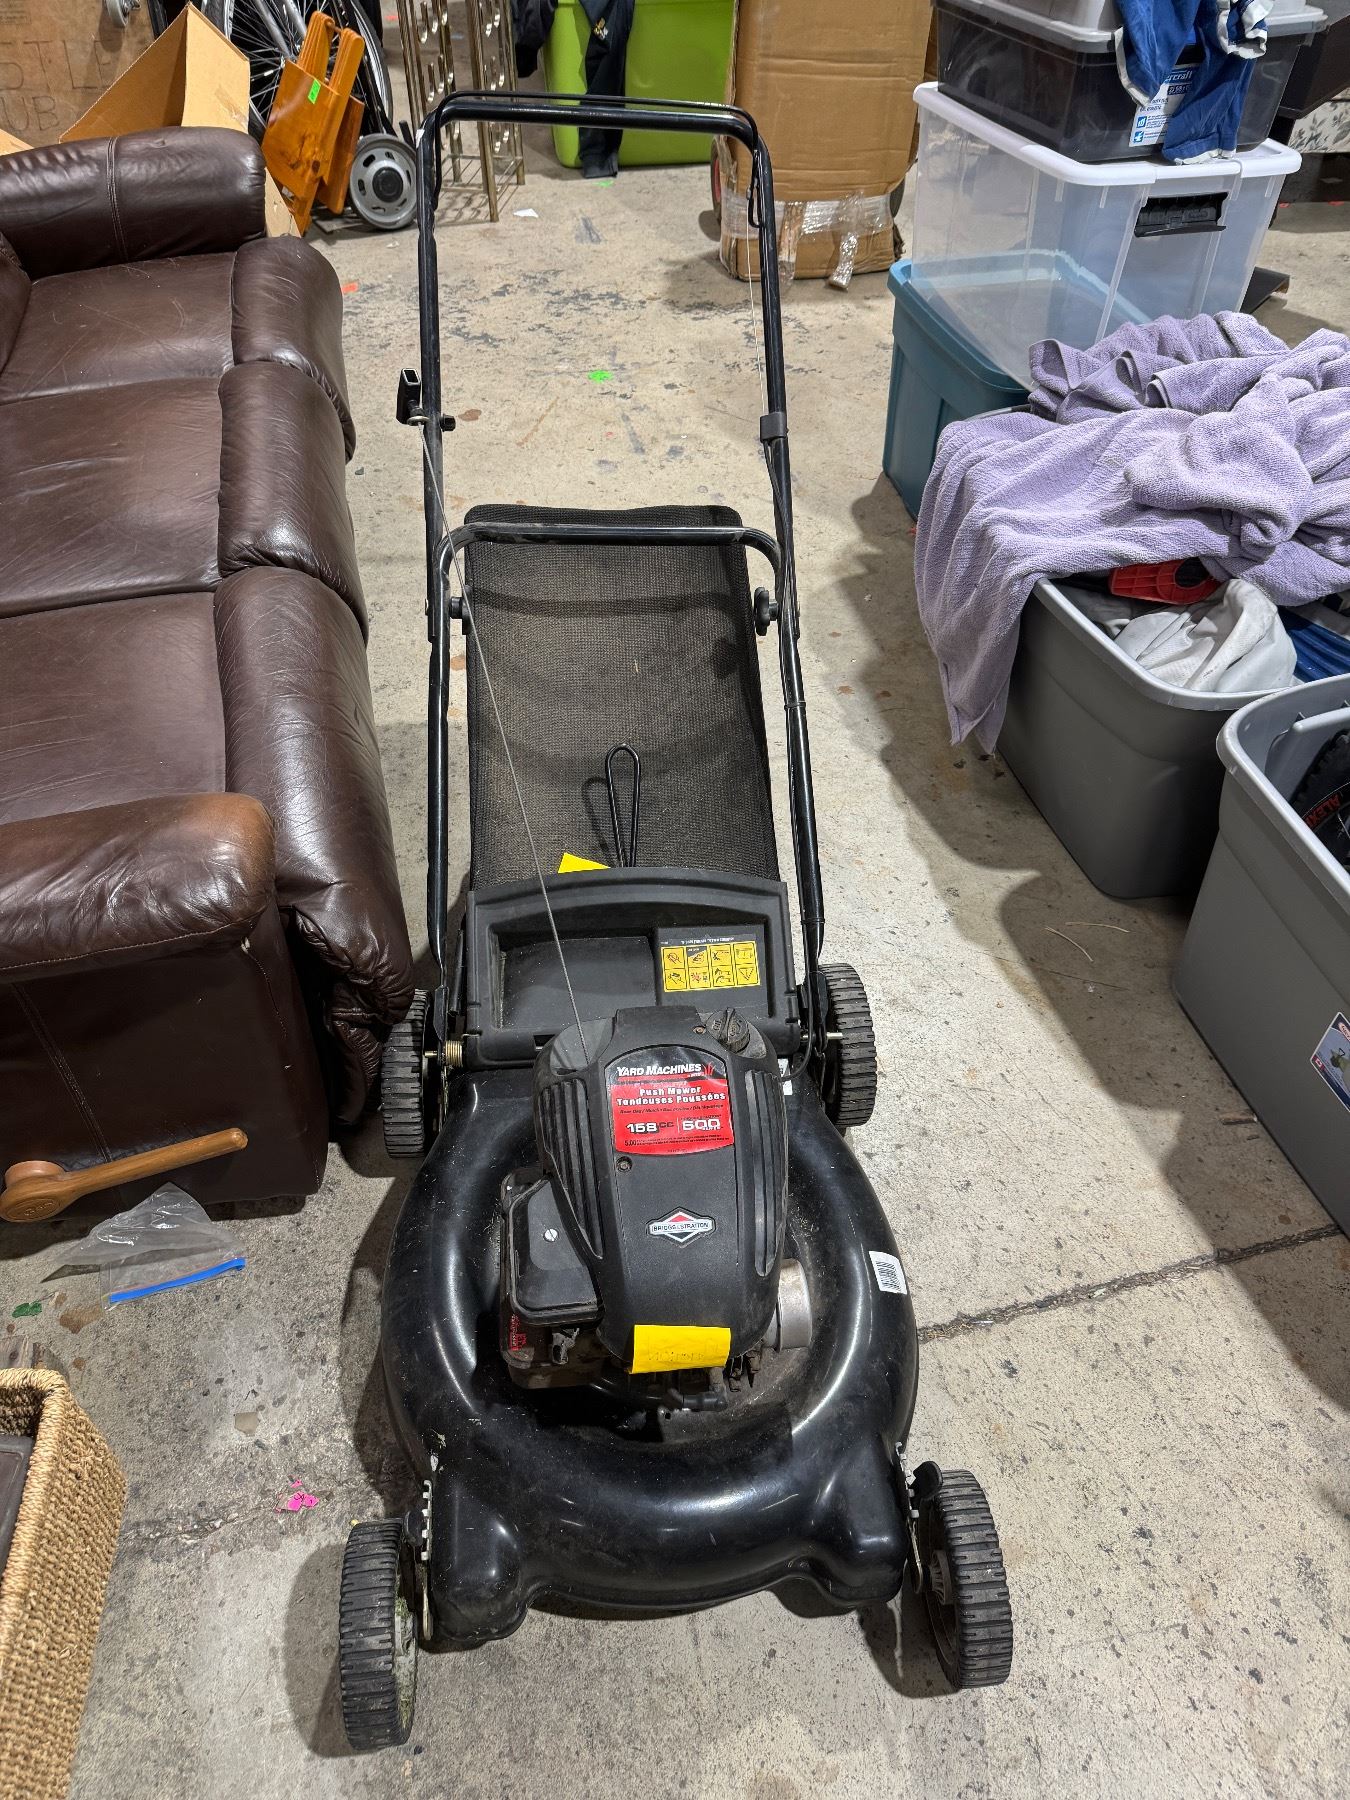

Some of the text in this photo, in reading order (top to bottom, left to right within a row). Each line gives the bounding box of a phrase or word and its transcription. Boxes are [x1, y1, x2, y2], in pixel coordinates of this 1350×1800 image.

[616, 1066, 645, 1077] YARD
[645, 1063, 702, 1076] MACHINES
[639, 1086, 702, 1097] Push Mower
